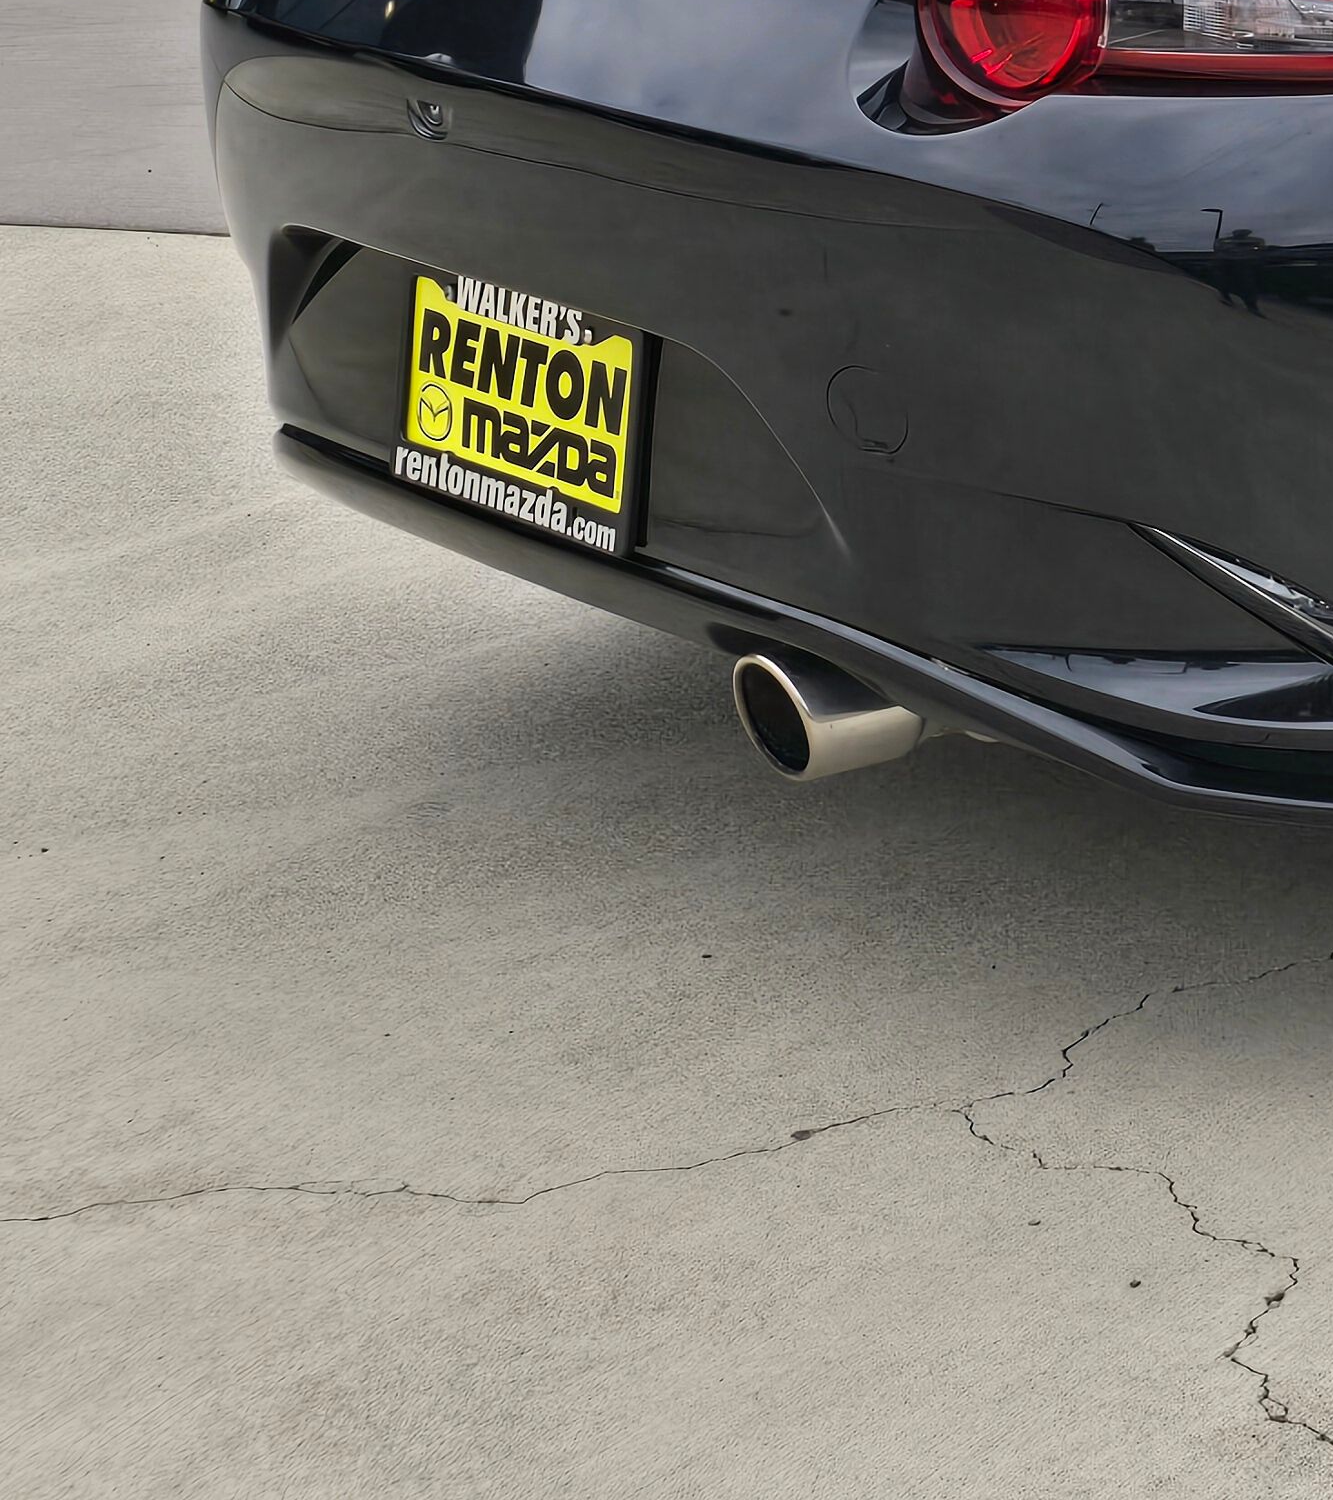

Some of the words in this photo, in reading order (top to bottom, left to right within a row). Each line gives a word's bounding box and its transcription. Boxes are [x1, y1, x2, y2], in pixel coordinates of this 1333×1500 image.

[456, 275, 583, 346] WALKER'S
[418, 307, 628, 436] RENTON
[394, 446, 616, 552] rentonmazda.com
[461, 396, 617, 499] mazda
